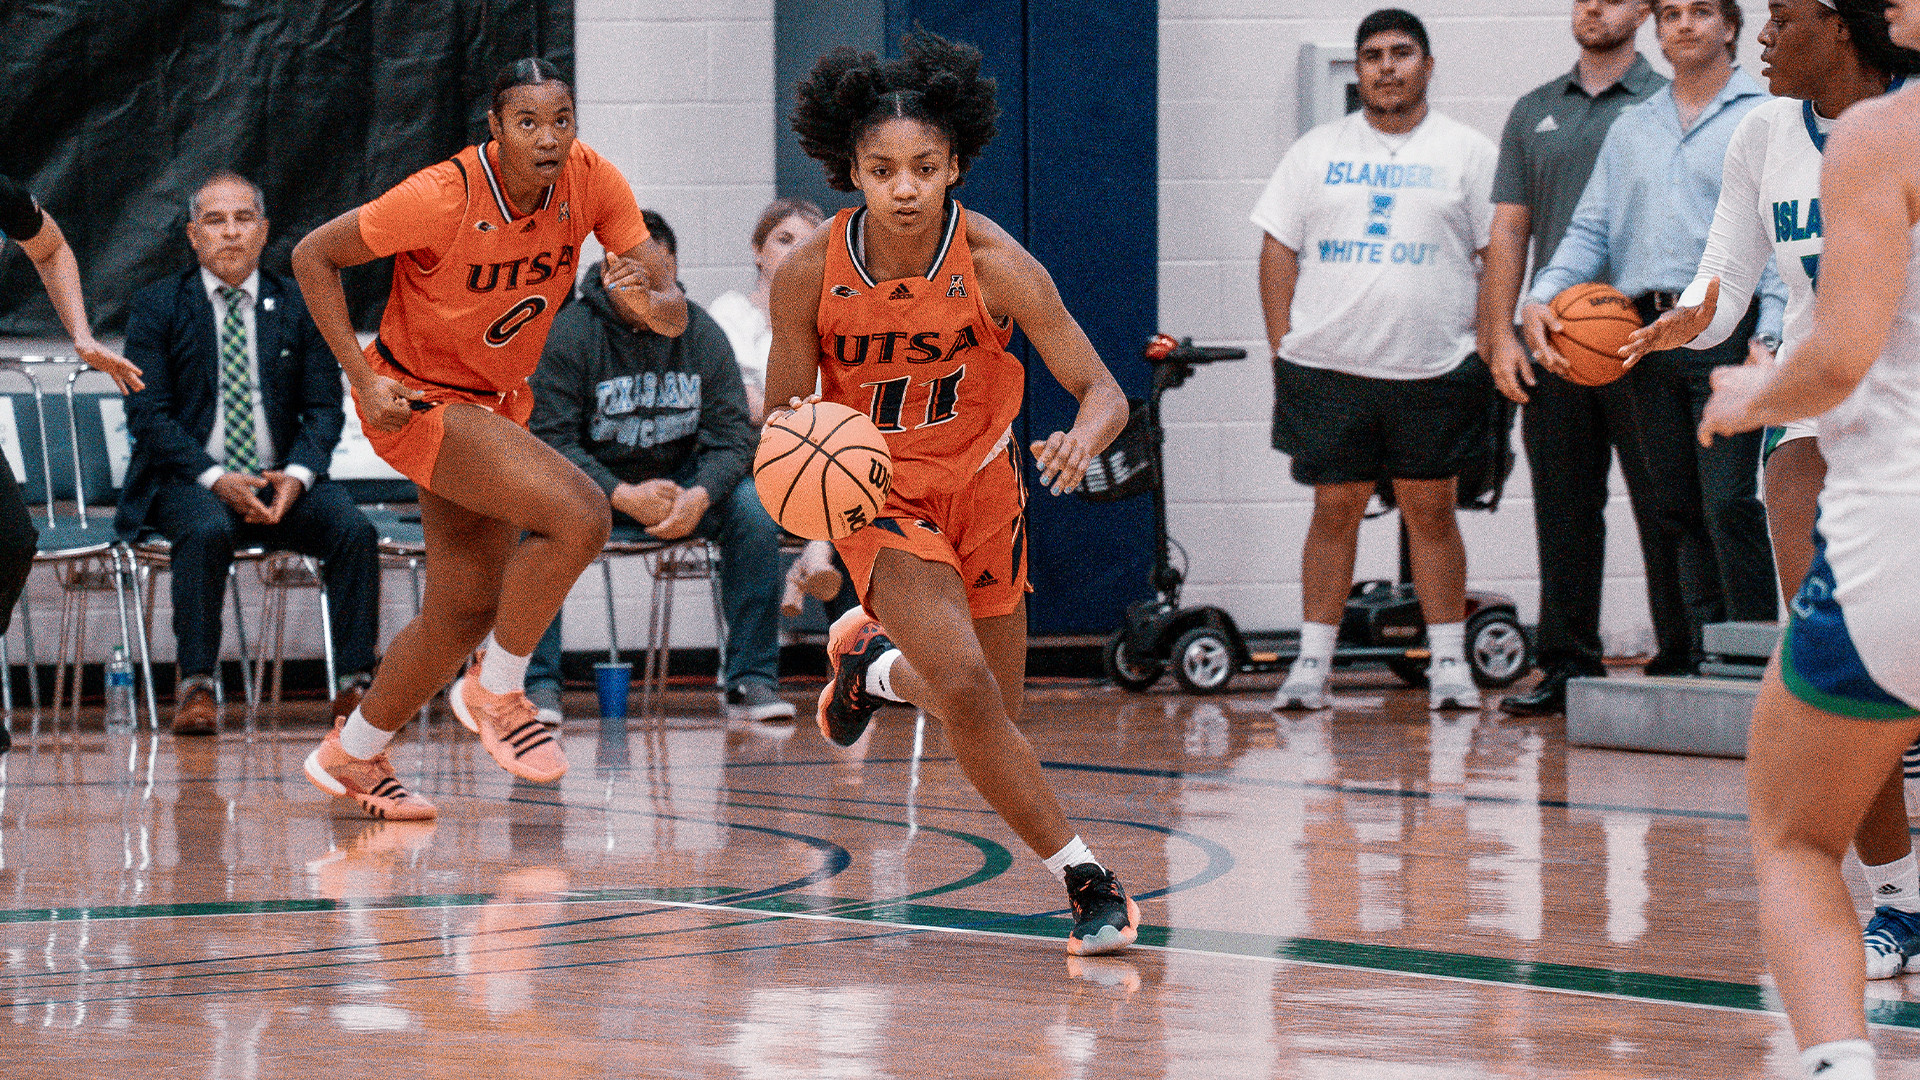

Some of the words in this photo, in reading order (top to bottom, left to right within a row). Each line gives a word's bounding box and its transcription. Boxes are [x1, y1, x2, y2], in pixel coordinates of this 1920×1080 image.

[466, 245, 574, 293] UTSA
[1318, 240, 1384, 264] WHITE
[1391, 242, 1440, 266] OUT
[484, 295, 547, 347] 0
[834, 325, 978, 366] UTSA
[860, 364, 966, 434] 11
